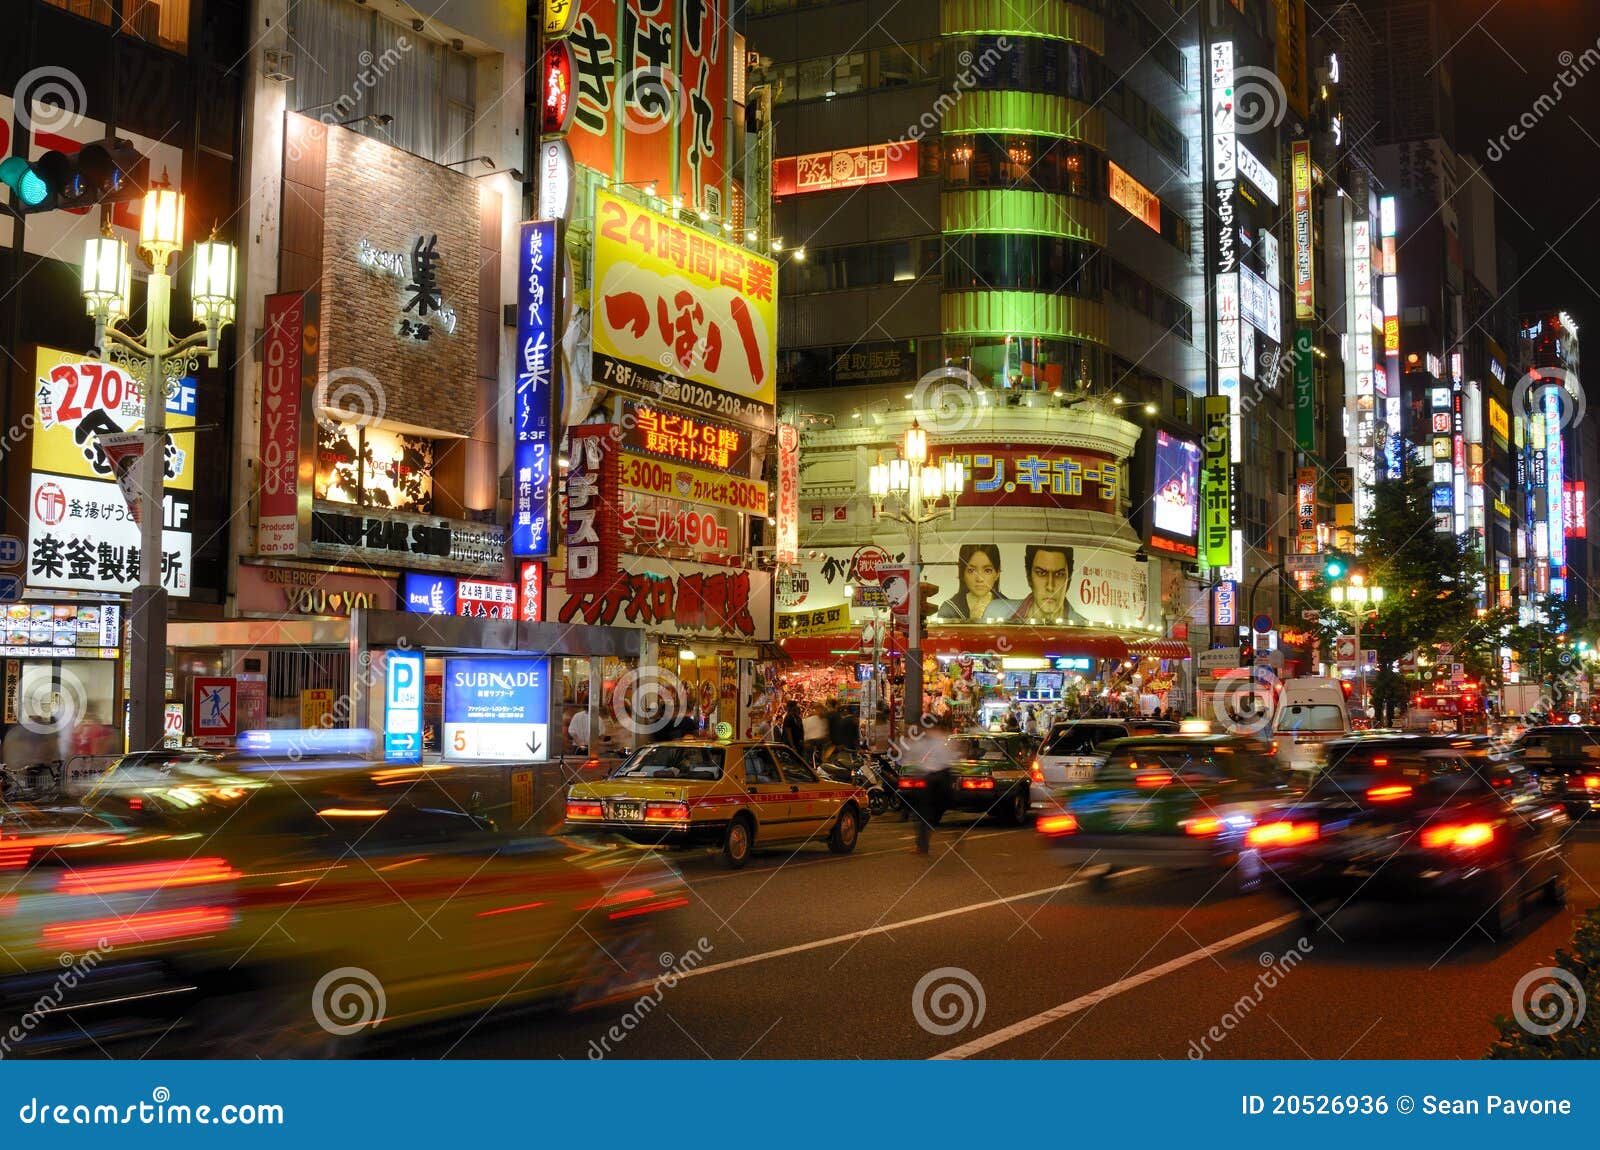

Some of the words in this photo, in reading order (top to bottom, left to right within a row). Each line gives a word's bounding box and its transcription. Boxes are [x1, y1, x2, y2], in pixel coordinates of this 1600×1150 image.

[547, 20, 562, 31] 4F
[600, 200, 774, 304] 24時間営業
[603, 290, 765, 386] つぼ八
[121, 401, 146, 418] 居酒
[637, 408, 739, 451] 当ビル6階
[568, 436, 601, 582] パチスロ
[260, 522, 296, 532] Produced
[619, 504, 730, 549] ビール190円
[460, 583, 514, 603] 24時間営業
[778, 608, 841, 630] 歌舞伎町
[455, 671, 540, 690] SUBNADE
[165, 713, 183, 730] 70
[453, 730, 467, 752] 5
